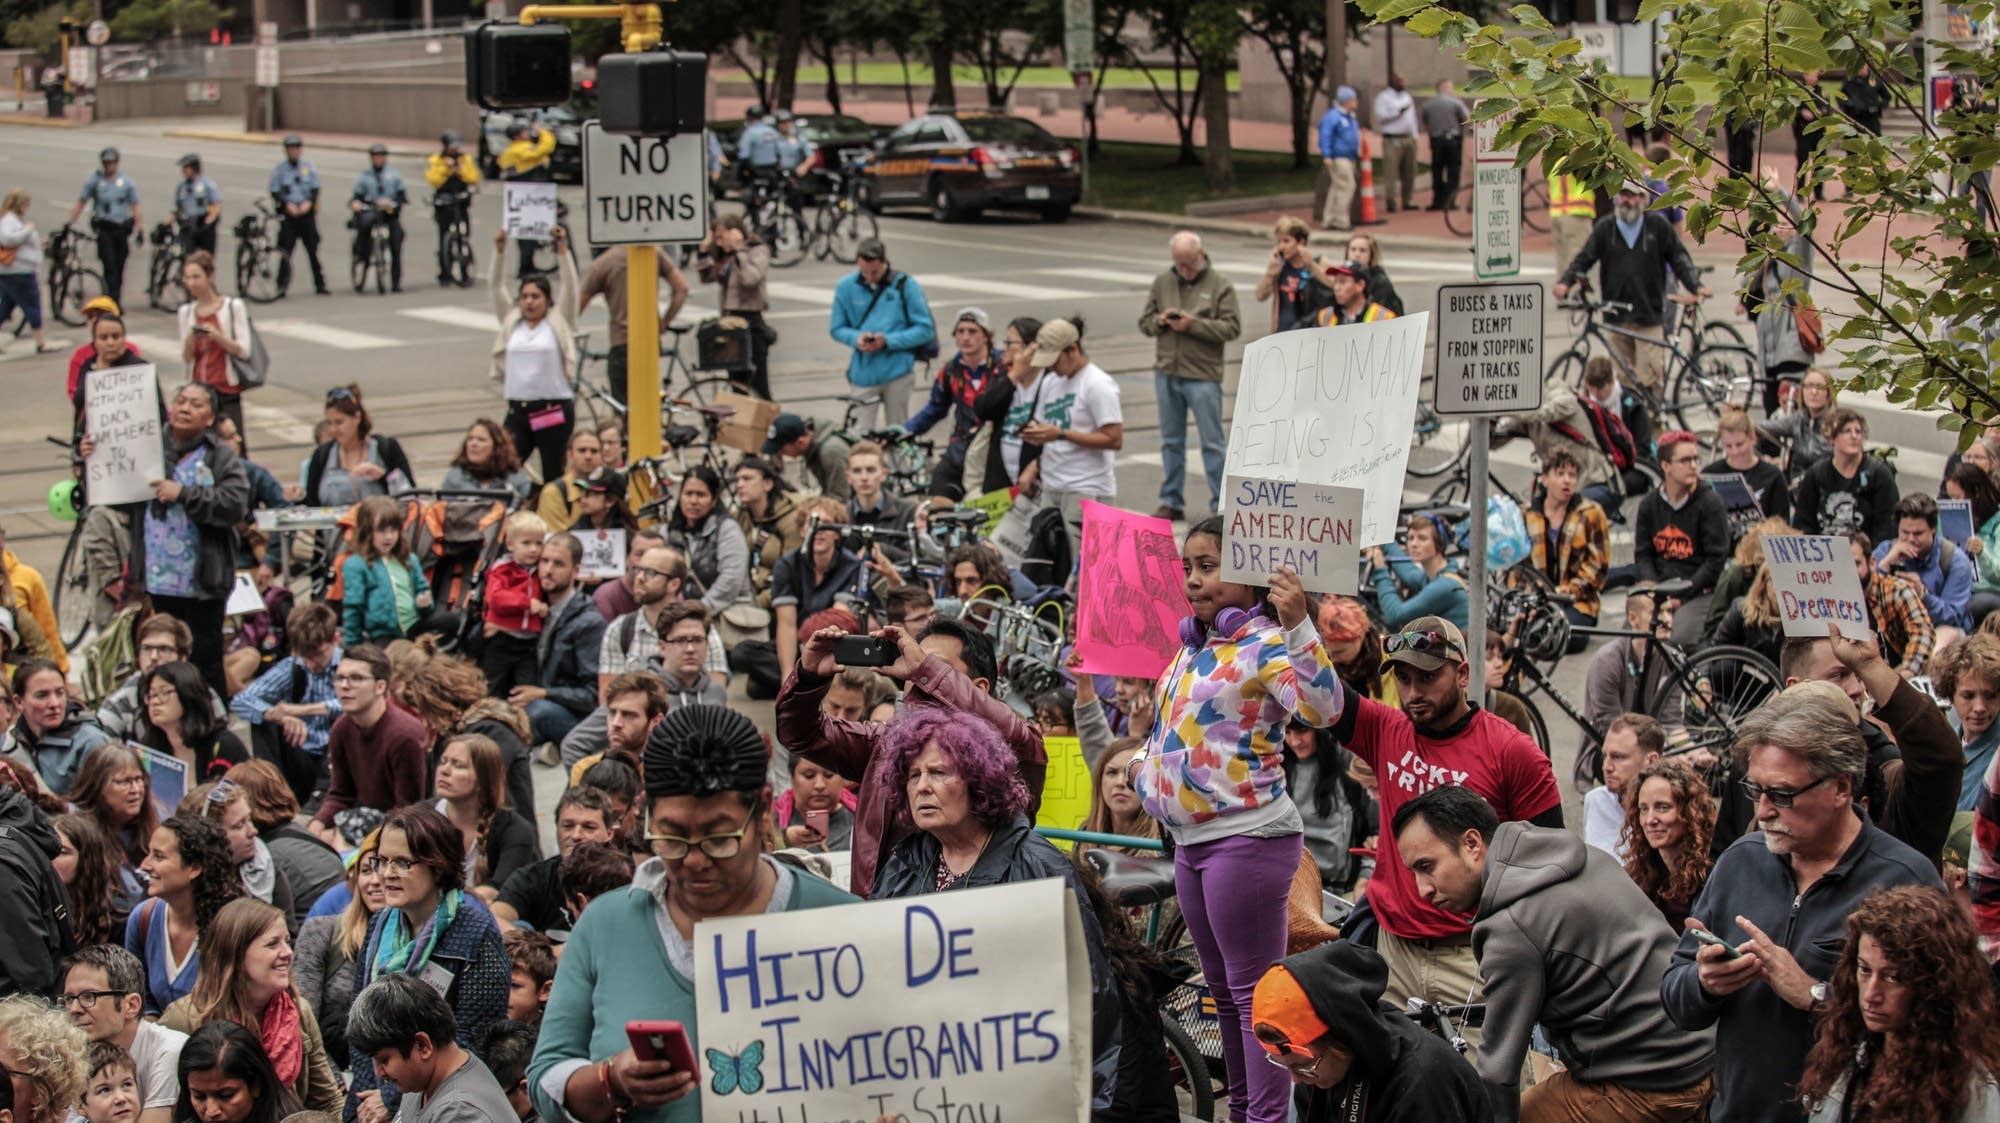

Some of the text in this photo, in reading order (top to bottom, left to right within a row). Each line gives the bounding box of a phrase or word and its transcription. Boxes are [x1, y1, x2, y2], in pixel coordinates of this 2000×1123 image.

[620, 142, 669, 174] NO
[1479, 168, 1518, 185] MINNEAPOLIS
[598, 194, 695, 222] TURNS
[1492, 189, 1505, 206] FIRE
[1487, 230, 1511, 248] VEHICLE
[1450, 294, 1533, 312] BUSES & TAXIS
[1472, 317, 1513, 334] EXEMPT
[1447, 338, 1534, 357] FROM STOPPING
[1294, 325, 1422, 403] HUMAN
[1462, 361, 1520, 379] AT TRACKS
[1462, 384, 1518, 401] ON GREEN
[1349, 412, 1375, 448] IS
[91, 456, 137, 481] STAY
[1236, 480, 1335, 508] SAVE the
[1229, 509, 1353, 545] AMERICAN
[1231, 541, 1318, 576] DREAM
[1768, 537, 1834, 563] INVEST
[1796, 569, 1808, 585] in
[1780, 590, 1864, 623] Dreamers
[1400, 750, 1469, 787] ICKY
[713, 928, 865, 1014] HIJO
[761, 1009, 1061, 1094] INMIGRANTES
[1349, 1081, 1363, 1122] DIGITAL
